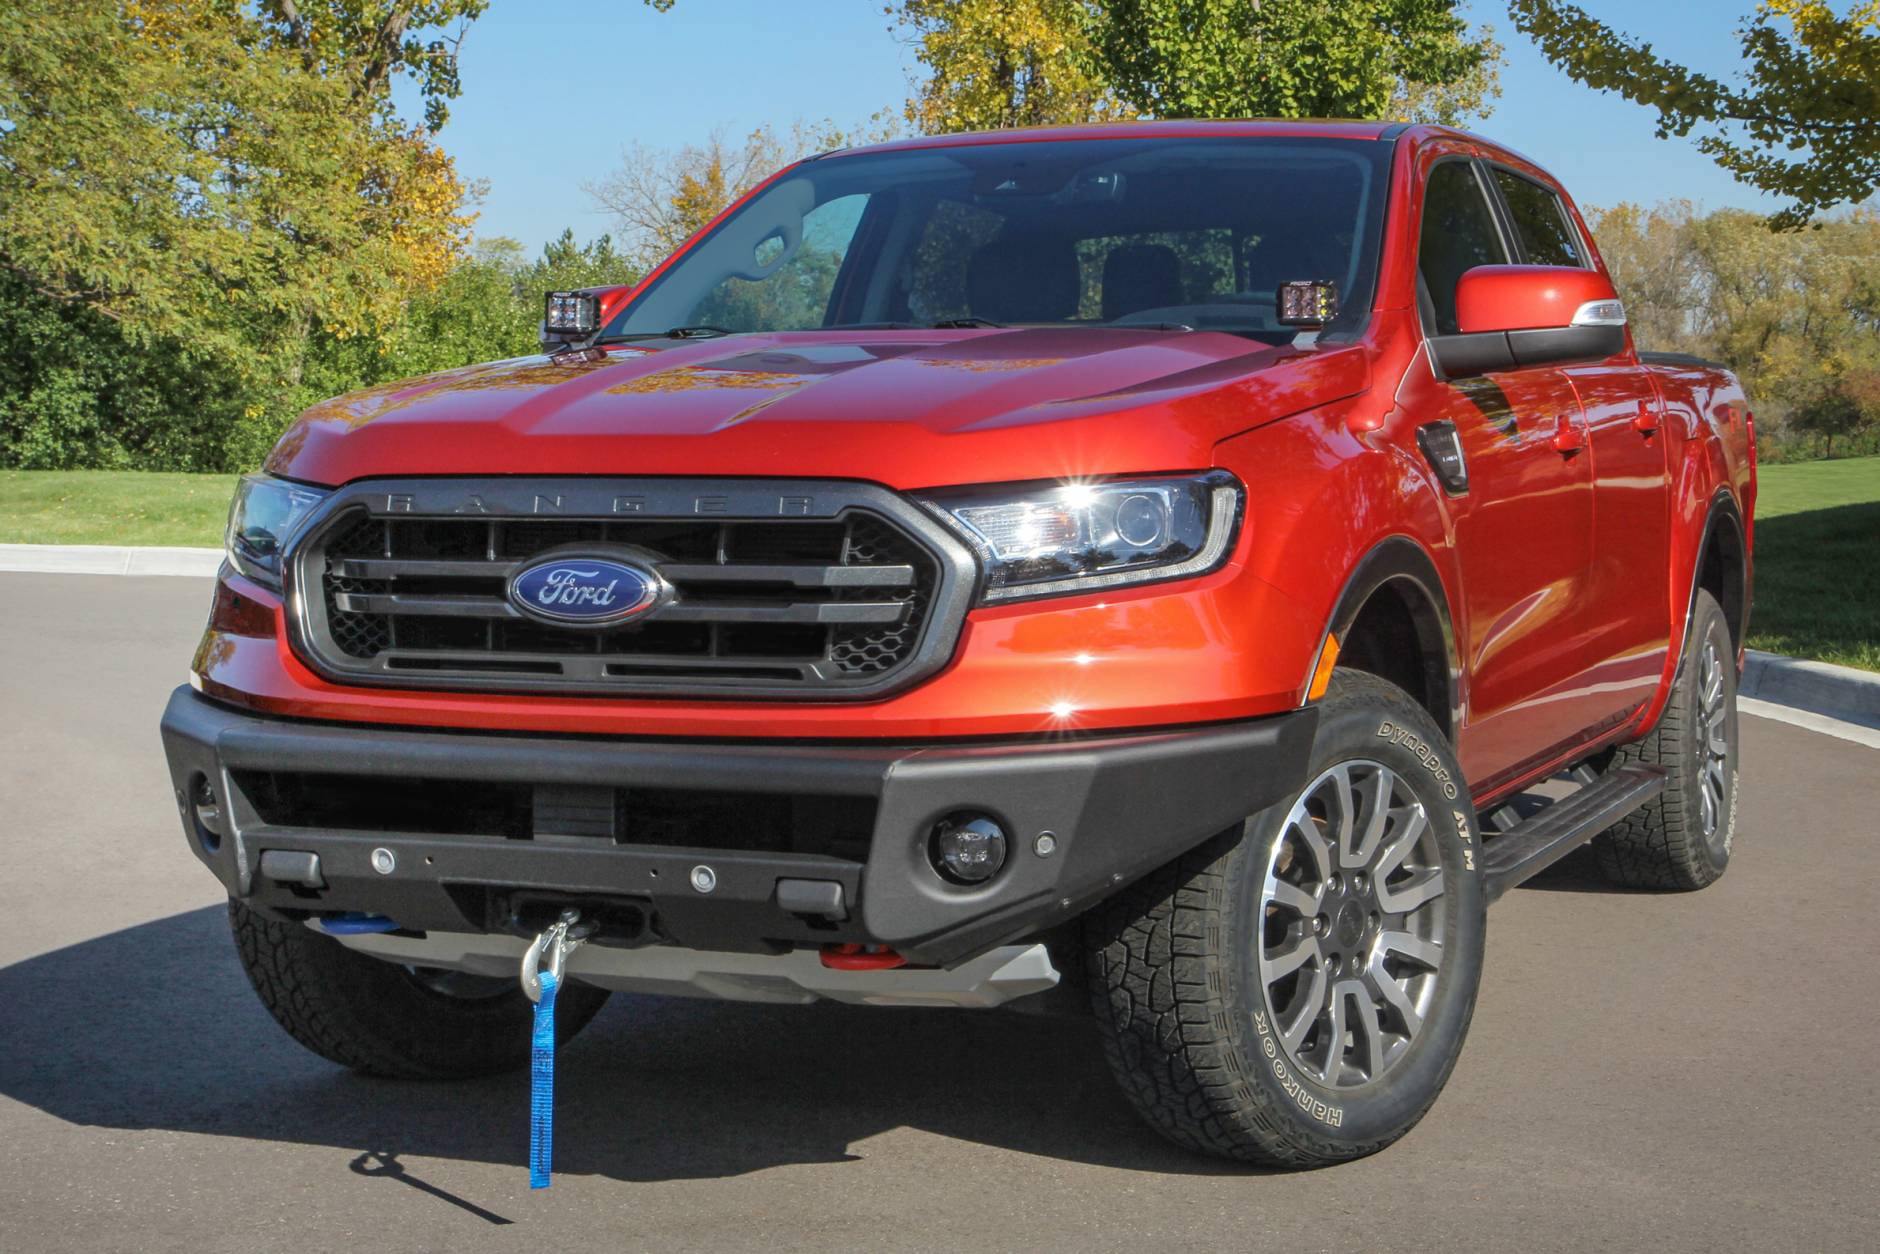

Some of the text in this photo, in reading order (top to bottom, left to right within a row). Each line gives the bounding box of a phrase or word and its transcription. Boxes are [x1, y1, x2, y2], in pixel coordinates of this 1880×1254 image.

[386, 494, 815, 514] RANGER
[538, 568, 619, 606] Ford
[1376, 720, 1459, 801] Dynapro
